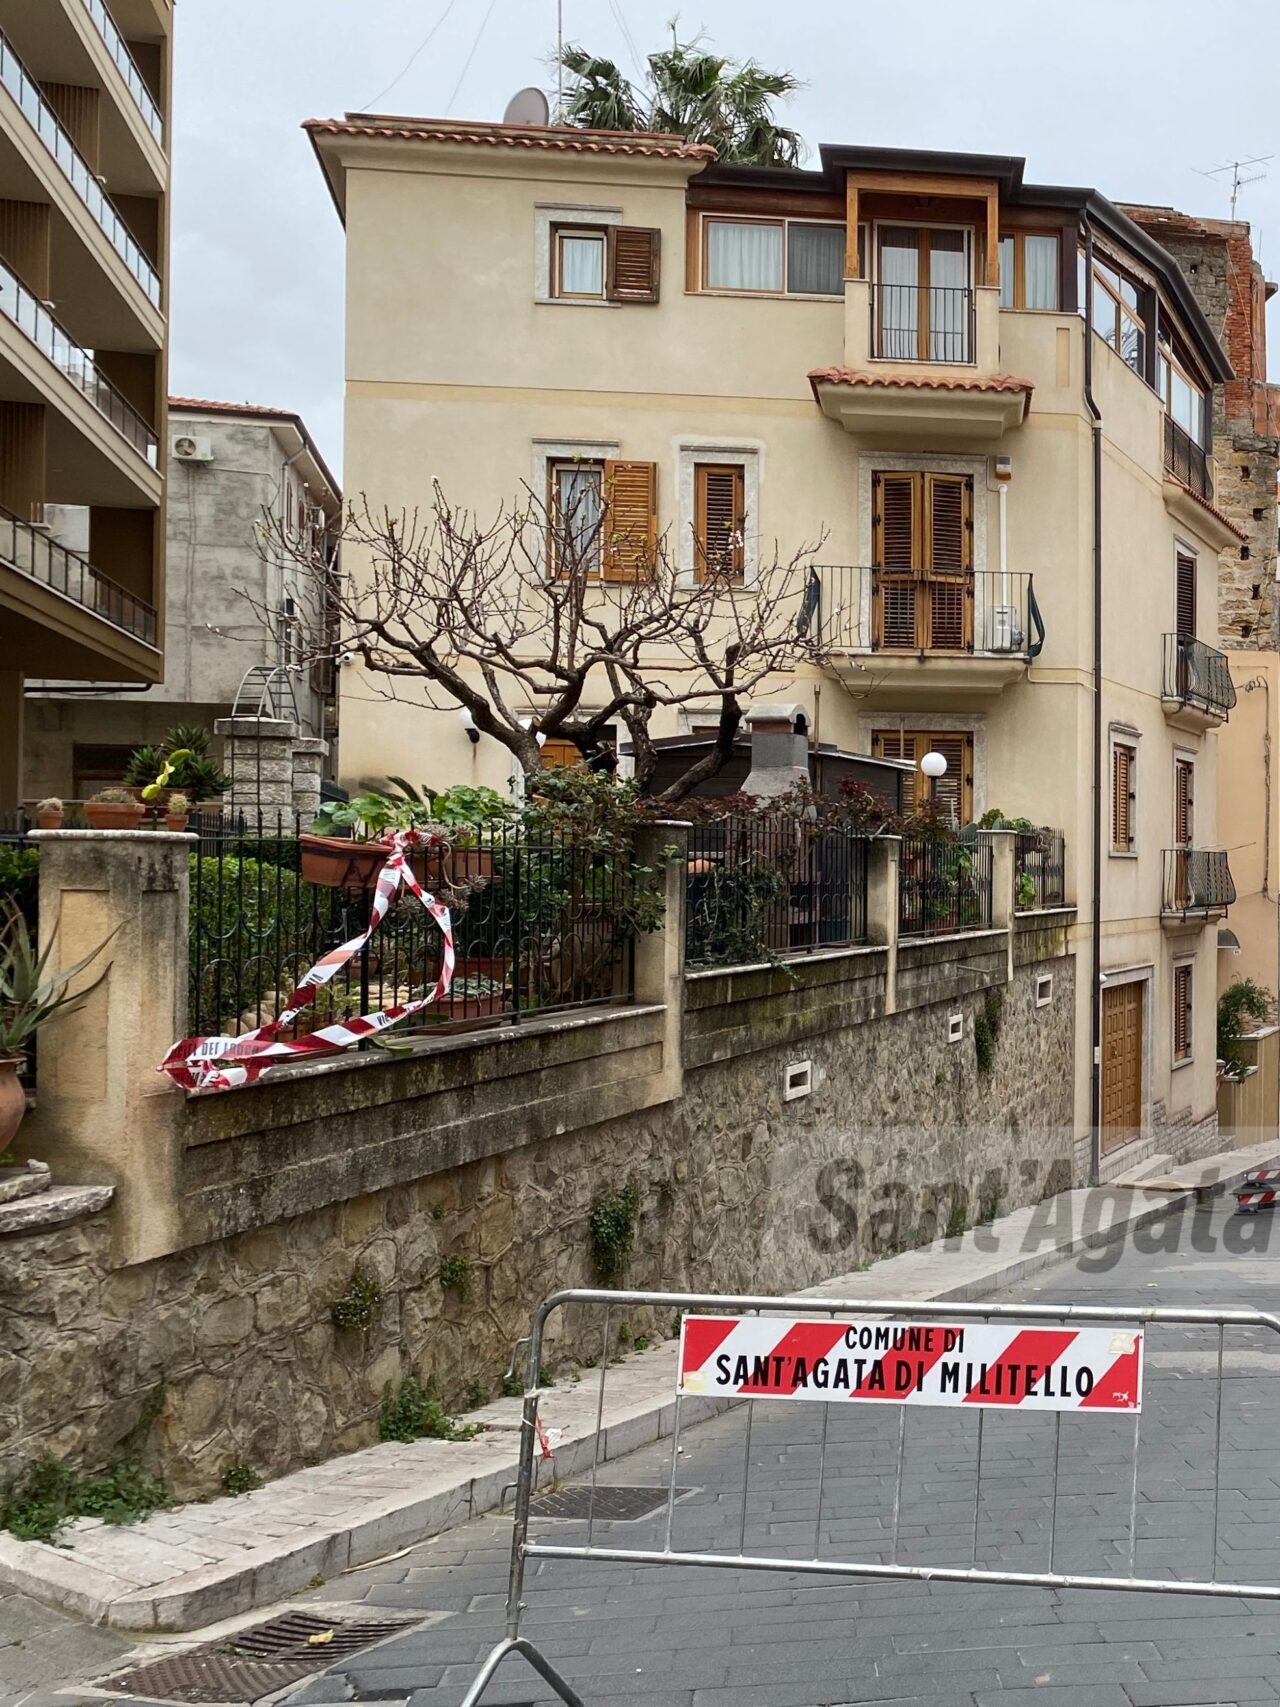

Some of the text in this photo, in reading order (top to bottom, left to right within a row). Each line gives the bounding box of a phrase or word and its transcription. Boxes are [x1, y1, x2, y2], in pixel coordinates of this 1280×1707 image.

[845, 1325, 964, 1354] COMUNE DI
[715, 1353, 1094, 1398] SANT'AGATA DI MILITELLO
